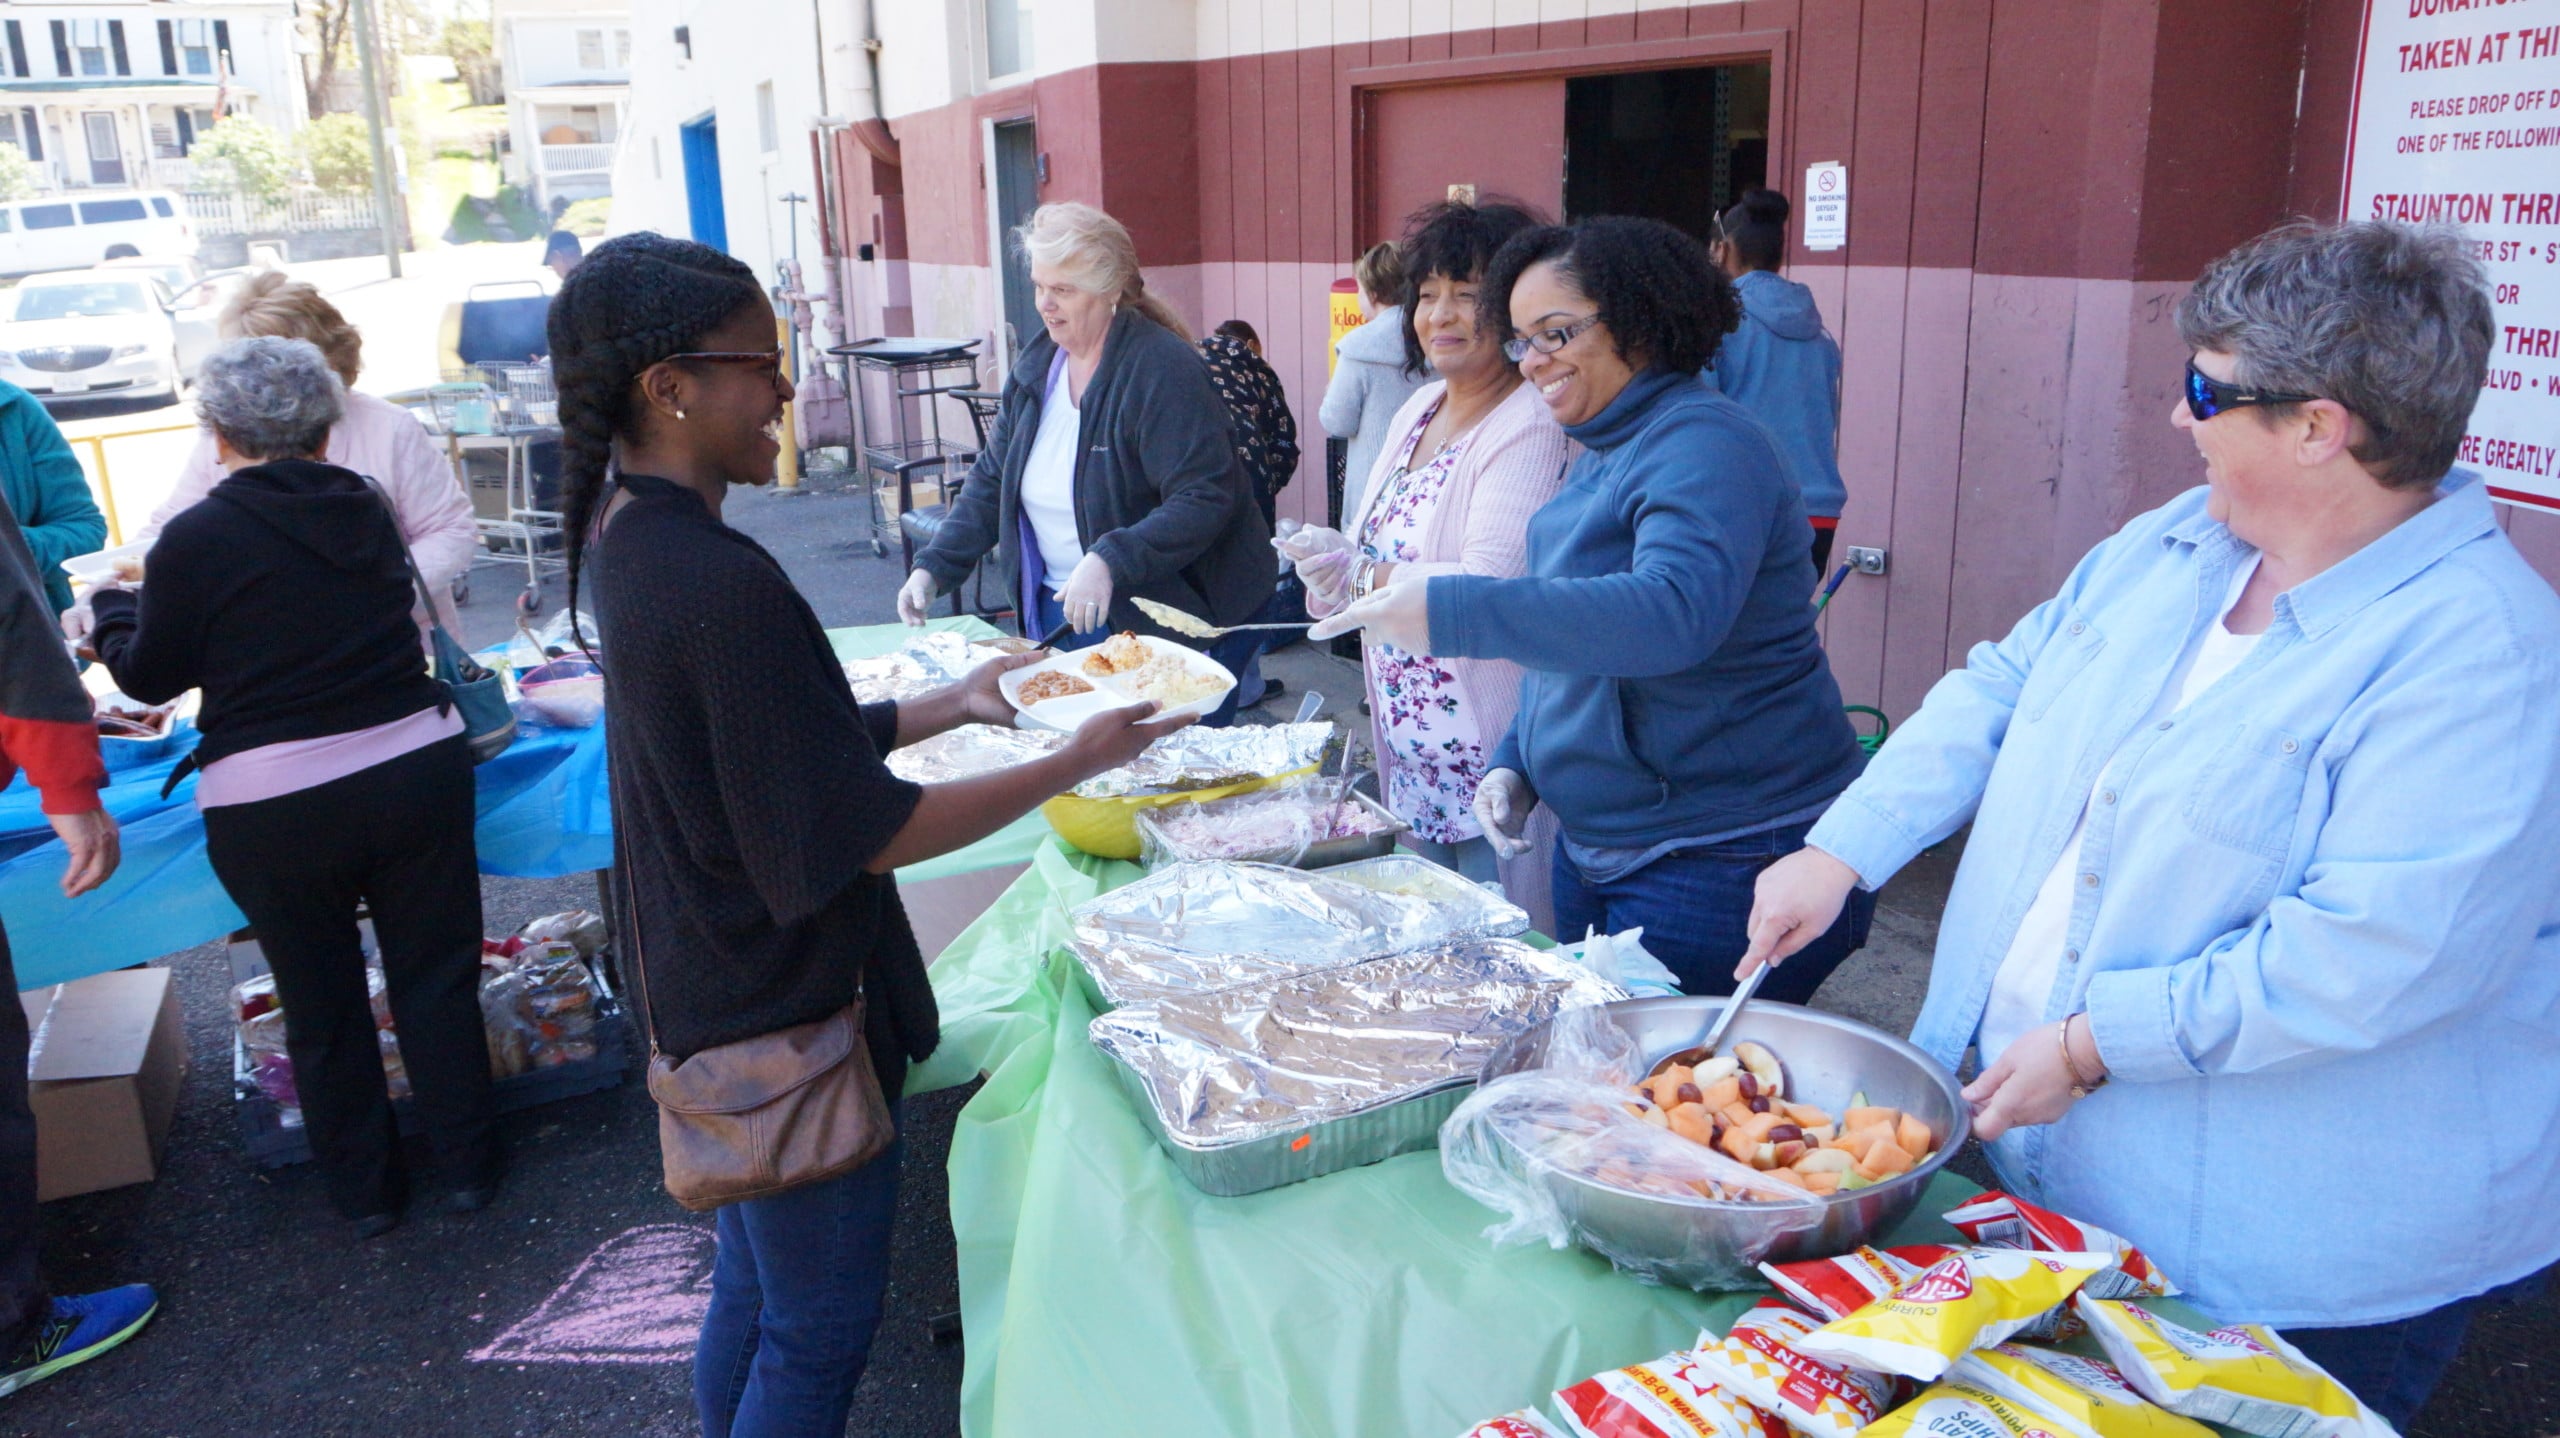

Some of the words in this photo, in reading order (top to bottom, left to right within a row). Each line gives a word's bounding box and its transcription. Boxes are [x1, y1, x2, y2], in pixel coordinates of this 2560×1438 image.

[2399, 36, 2472, 73] TAKEN
[2477, 32, 2510, 64] AT
[2410, 97, 2464, 119] PLEASE
[2468, 93, 2510, 114] DROP
[2514, 90, 2545, 111] OFF
[2397, 135, 2425, 154] ONE
[2429, 133, 2448, 152] OF
[2453, 131, 2481, 151] THE
[1808, 194, 1817, 202] NO
[1818, 193, 1845, 202] SMOKING
[1815, 204, 1838, 212] OXYGEN
[2371, 193, 2493, 224] STAUNTON
[2499, 241, 2521, 261] ST
[2496, 283, 2520, 304] OR
[2485, 438, 2556, 476] GREATLY
[1751, 1333, 1877, 1422] MARTIN'S
[1670, 1397, 1715, 1436] WAFFLE
[1983, 1394, 2028, 1433] POTATO
